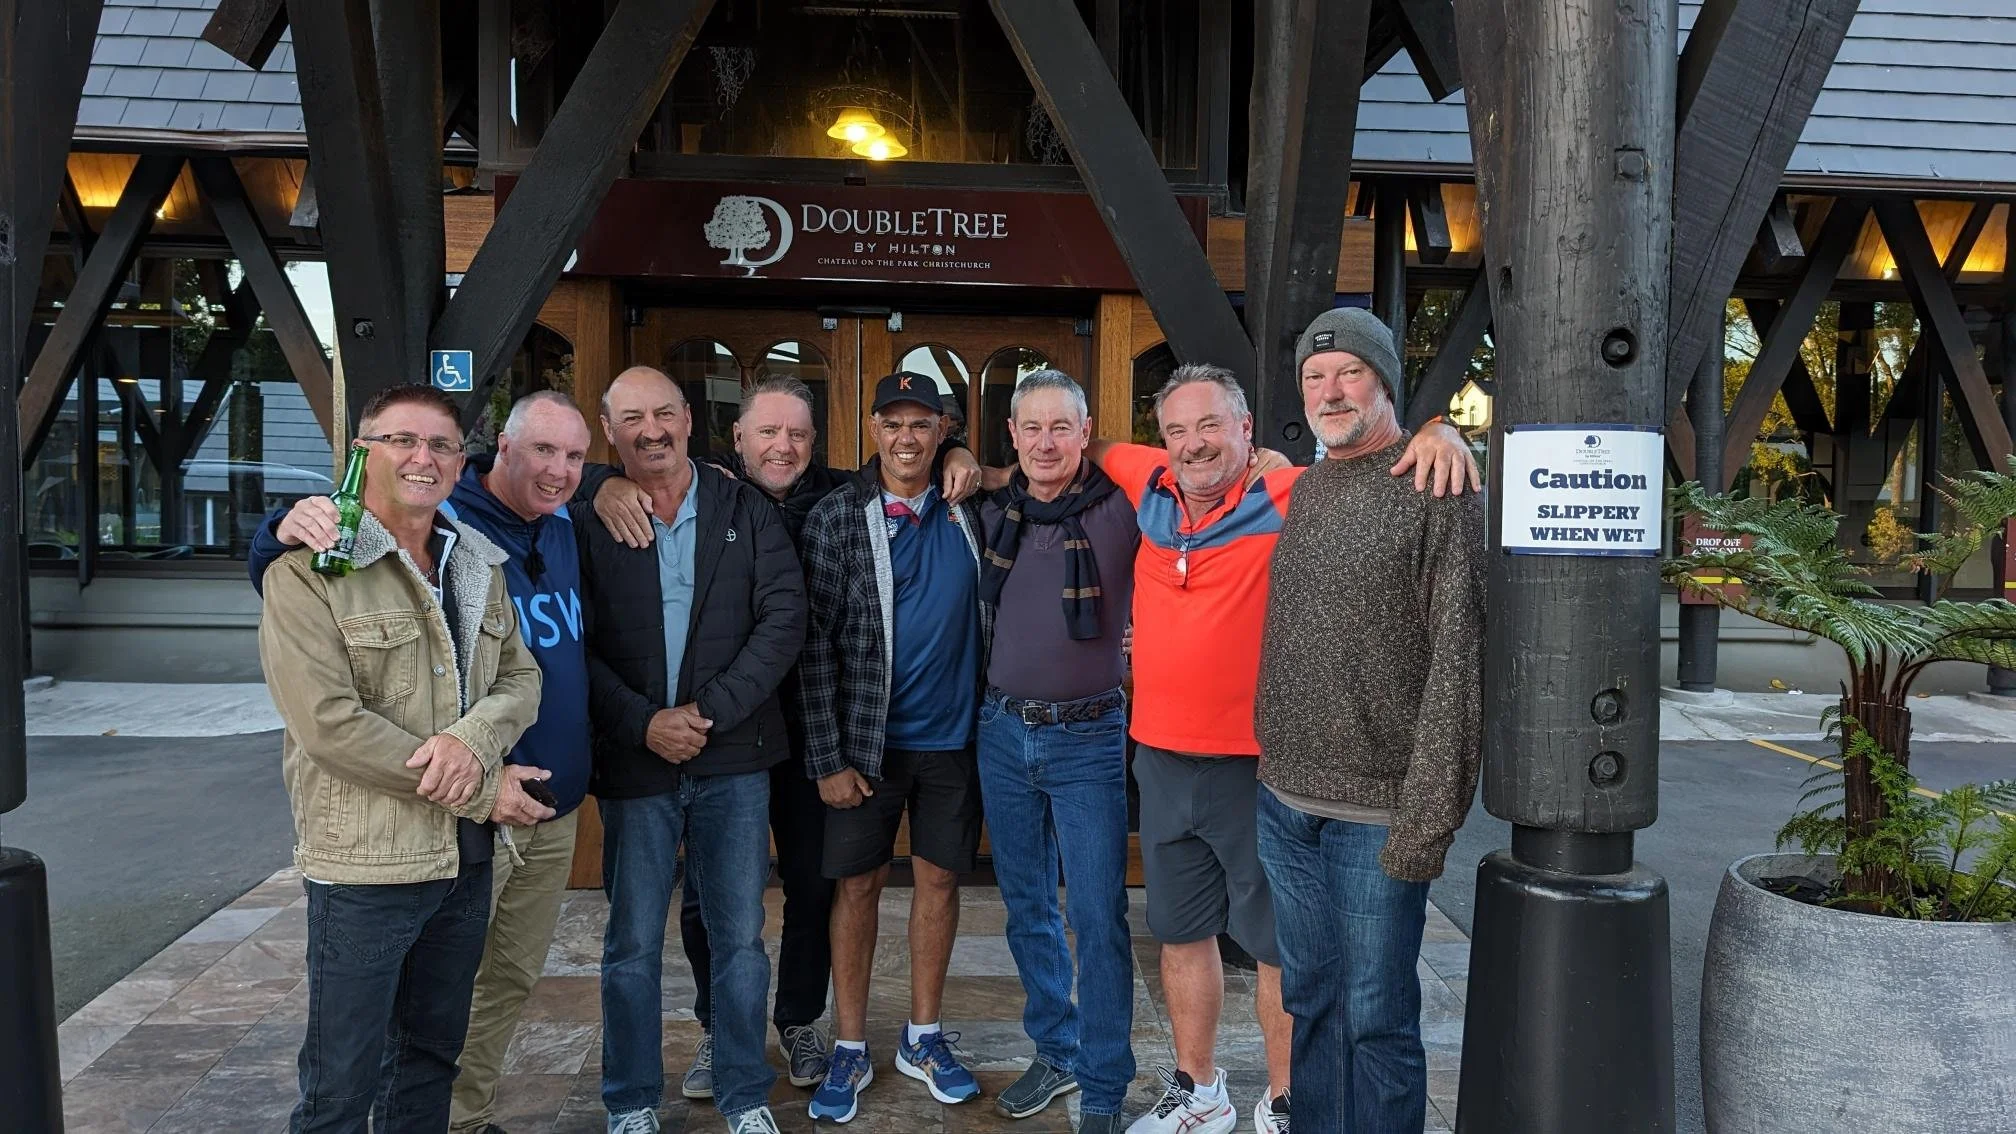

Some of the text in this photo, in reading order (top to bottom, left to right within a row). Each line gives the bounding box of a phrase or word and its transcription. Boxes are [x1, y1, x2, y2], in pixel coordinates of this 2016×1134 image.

[801, 204, 1009, 239] DOUBLETREE
[854, 242, 955, 255] BY HILTON
[817, 257, 858, 266] CHATEAU
[877, 259, 894, 267] THE
[923, 261, 991, 269] CHRISTCHURCH
[899, 376, 912, 390] K
[1529, 468, 1647, 490] Caution
[1537, 504, 1640, 520] SLIPPERY
[1530, 526, 1645, 543] WHEN WET
[1695, 537, 1741, 547] DROP OFF
